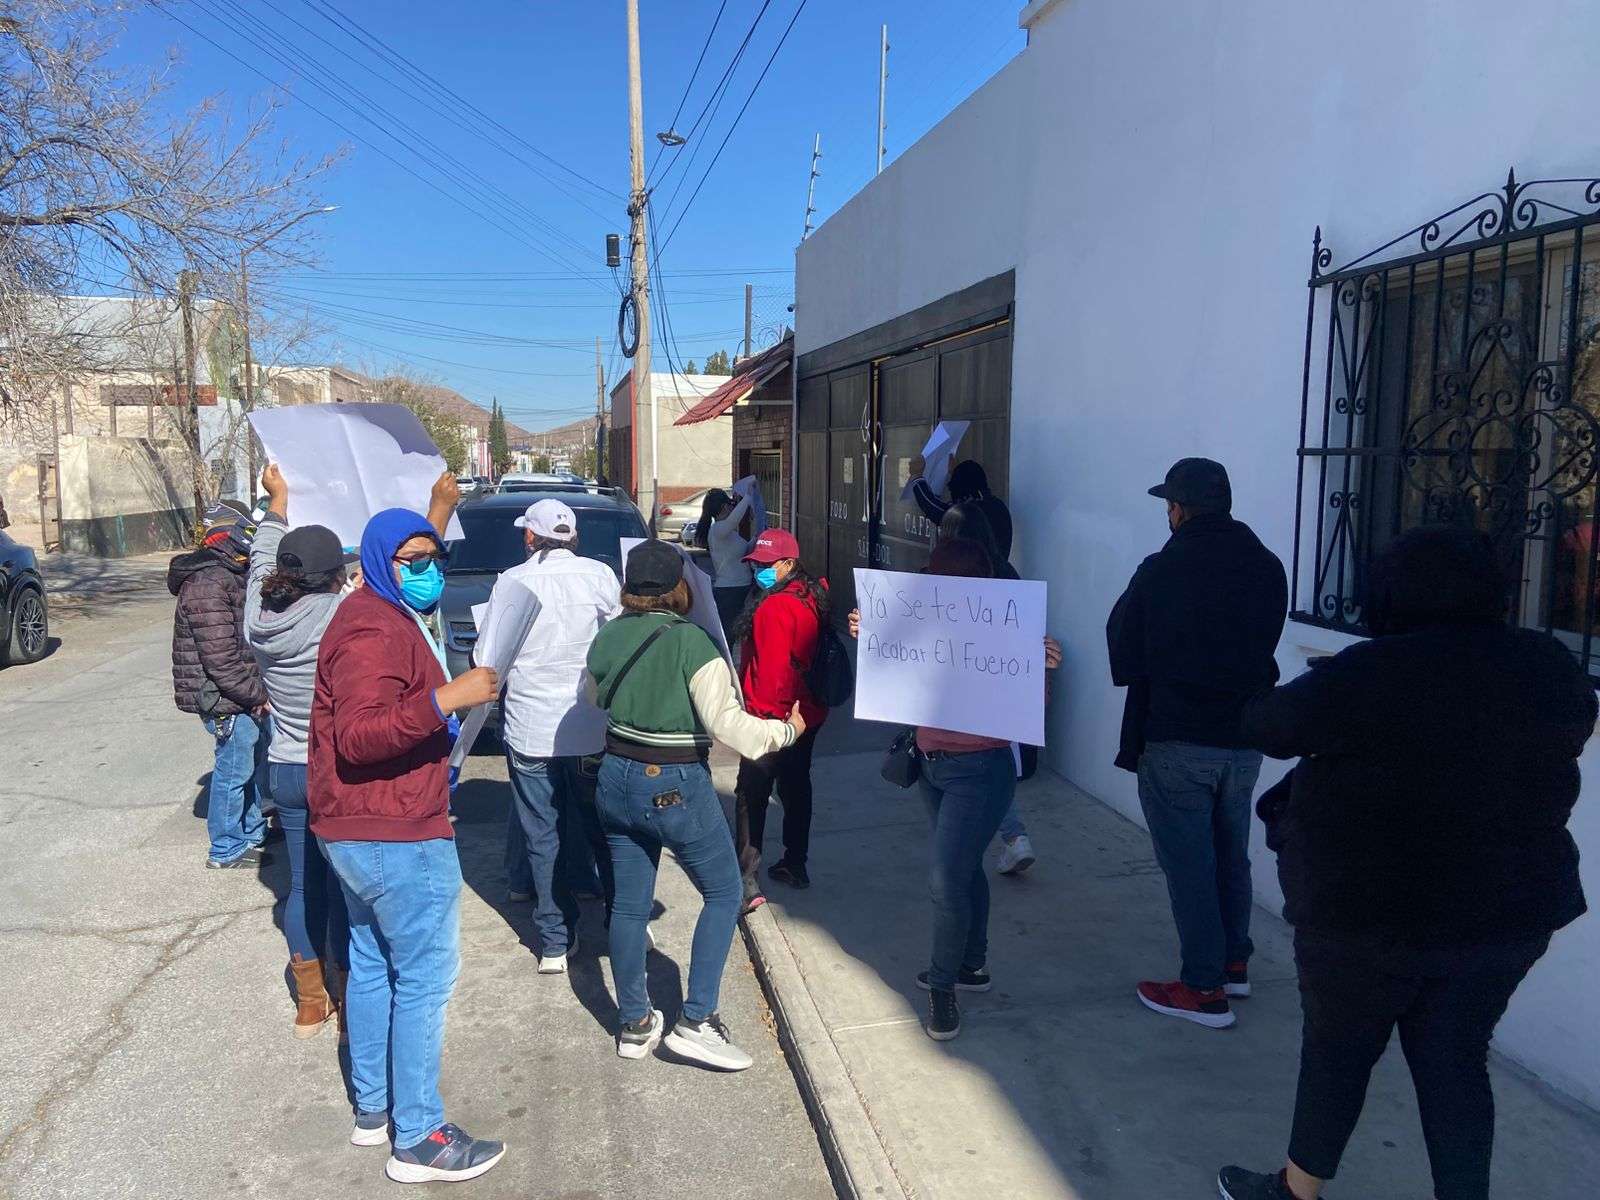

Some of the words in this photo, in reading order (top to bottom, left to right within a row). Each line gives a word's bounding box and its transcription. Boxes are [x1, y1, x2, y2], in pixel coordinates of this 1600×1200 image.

[862, 582, 887, 619] Ya
[967, 596, 993, 625] Va
[1004, 599, 1020, 629] A
[867, 633, 927, 663] Acabar
[935, 639, 955, 668] El
